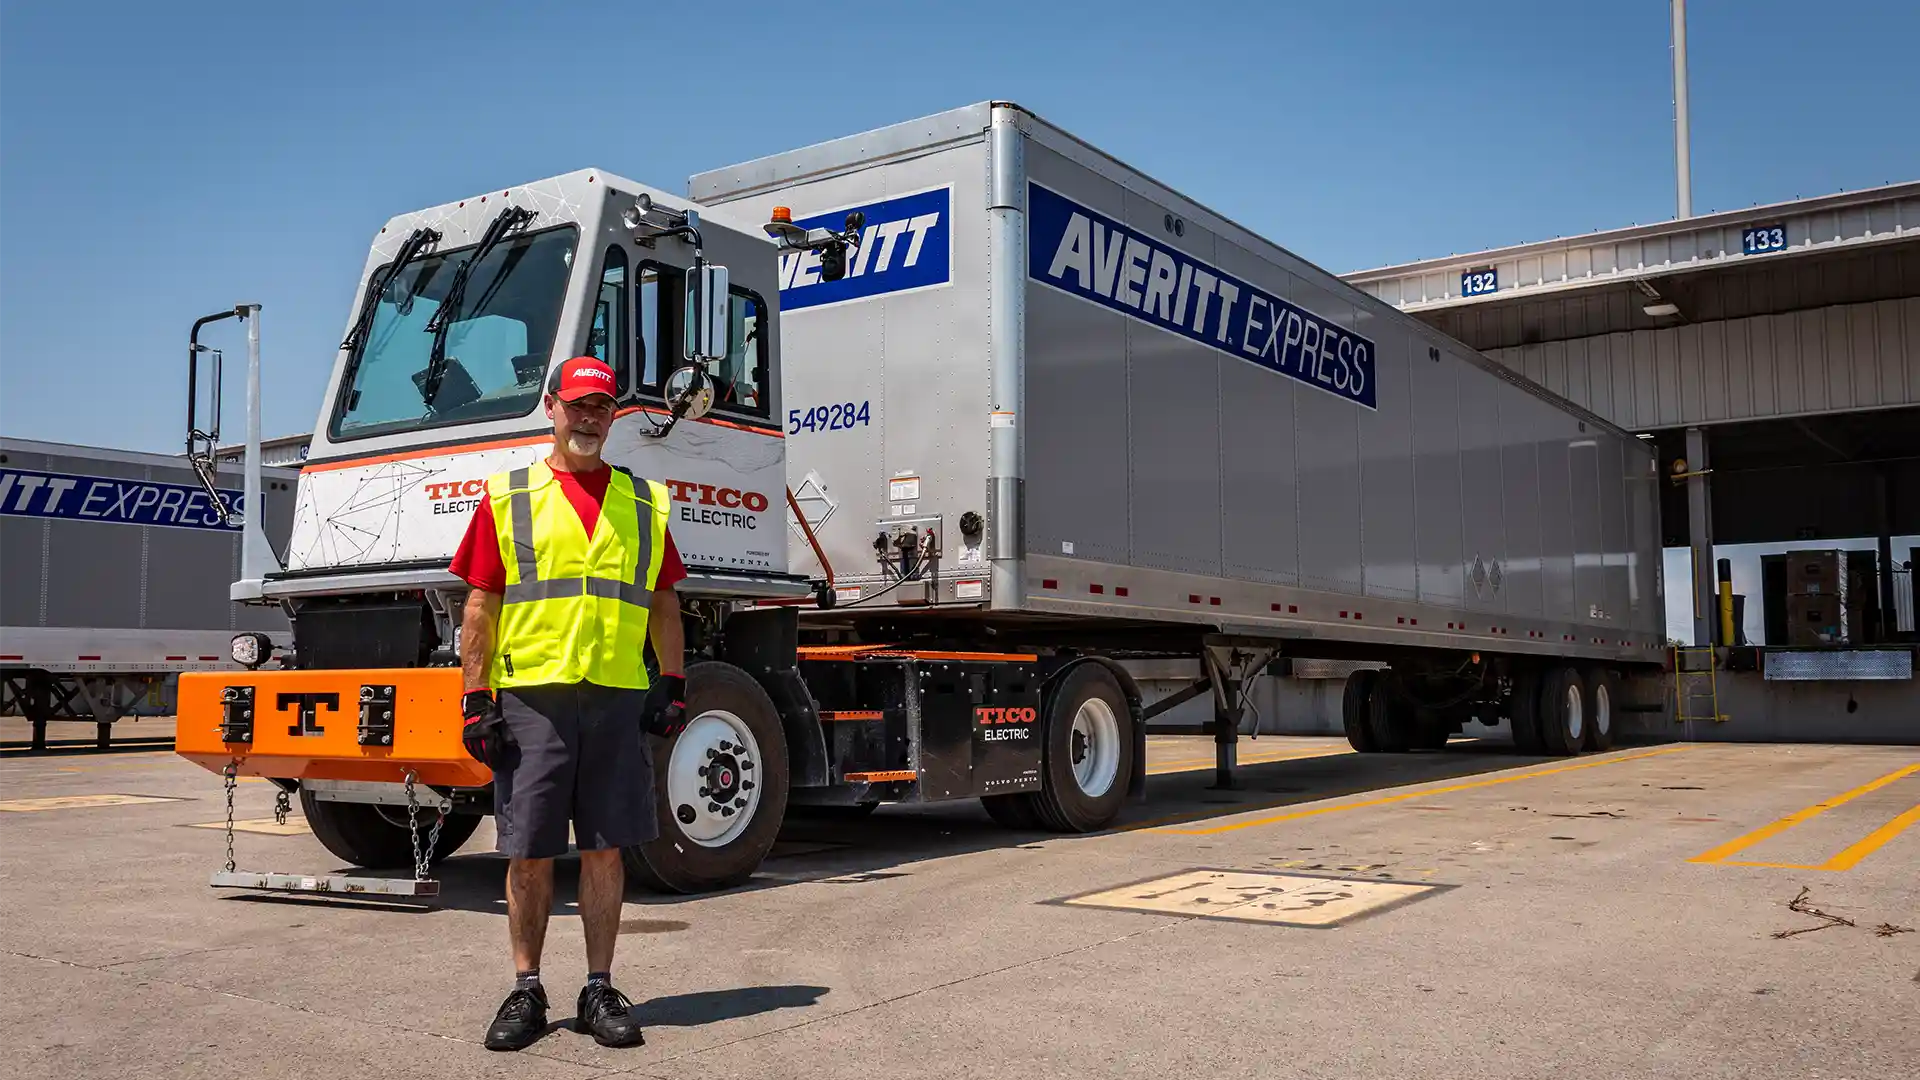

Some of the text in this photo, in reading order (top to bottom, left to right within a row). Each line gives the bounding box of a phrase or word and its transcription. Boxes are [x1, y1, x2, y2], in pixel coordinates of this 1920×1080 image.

[1745, 228, 1784, 251] 133
[1463, 272, 1496, 294] 132
[1048, 211, 1367, 396] AVERITT EXPRESS
[572, 368, 612, 382] AVERITT
[789, 400, 870, 435] 549284
[425, 479, 489, 500] TIC
[666, 479, 769, 512] TICO
[681, 507, 757, 530] ELECTRIC
[682, 553, 769, 567] VOLVO PENTA
[976, 707, 1036, 724] TICO
[984, 727, 1029, 741] ELECTRIC
